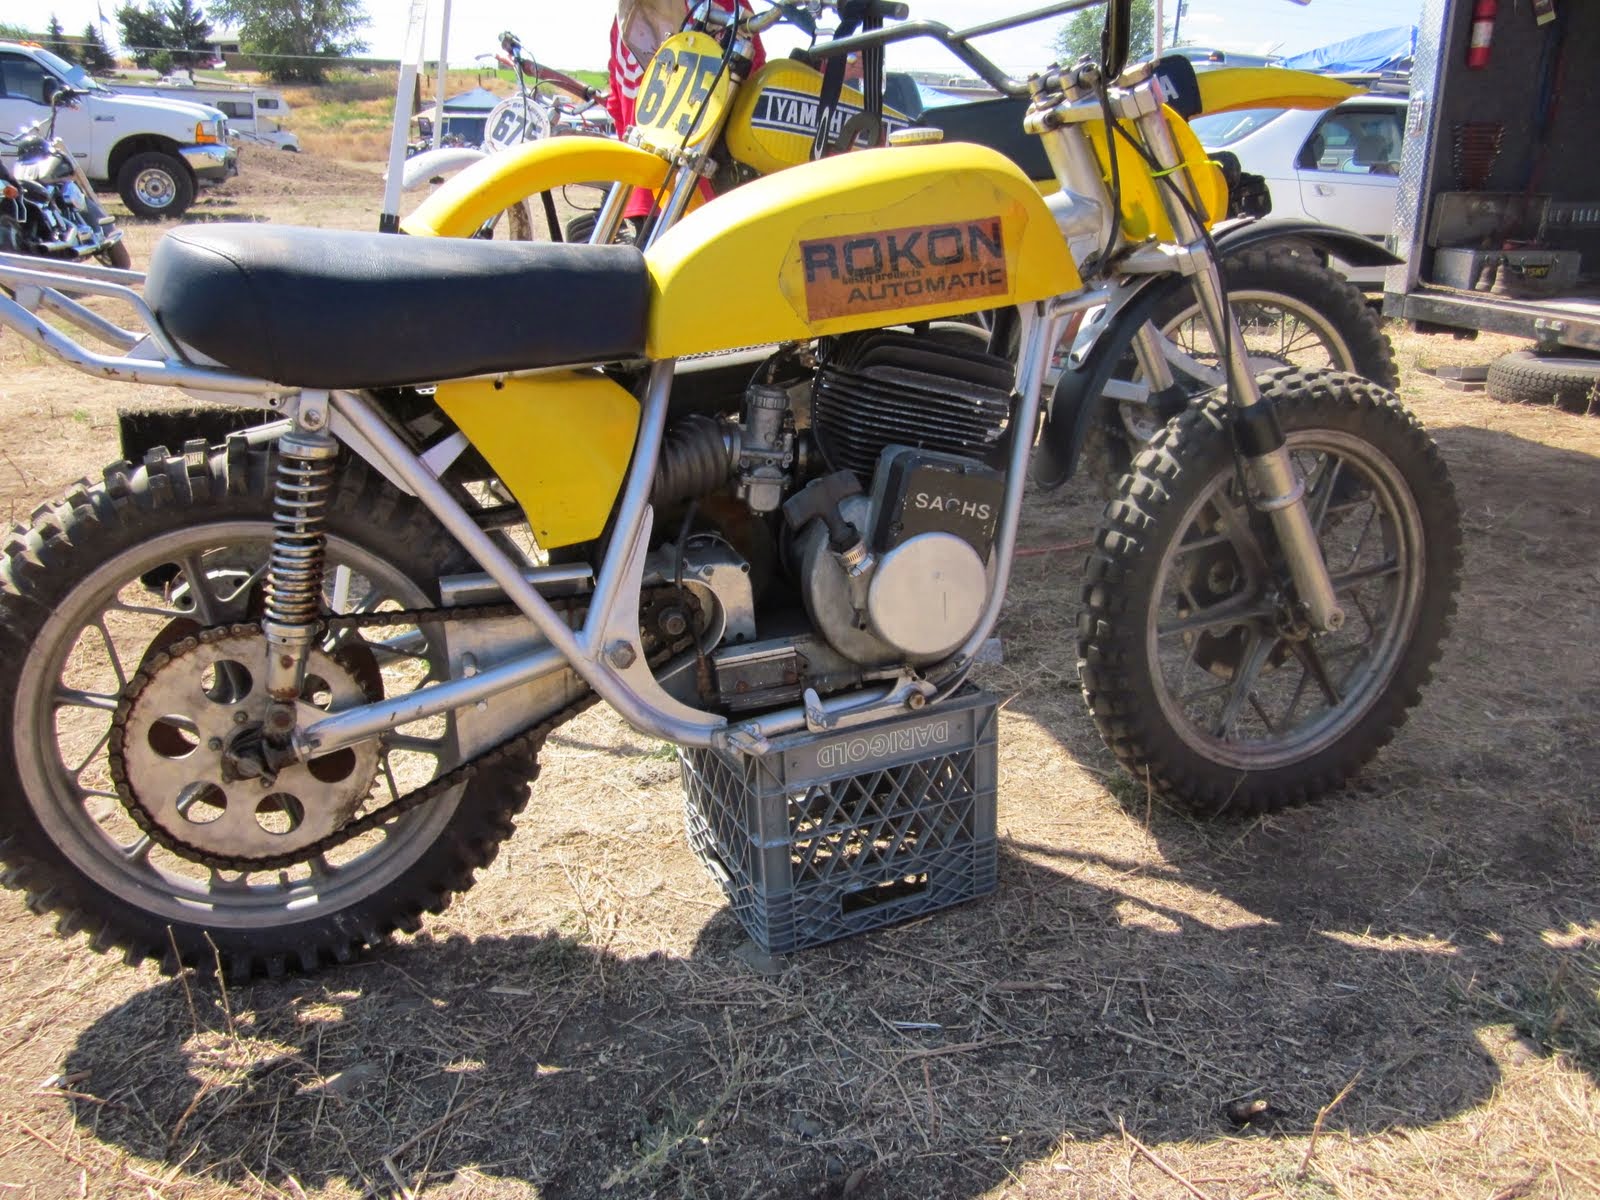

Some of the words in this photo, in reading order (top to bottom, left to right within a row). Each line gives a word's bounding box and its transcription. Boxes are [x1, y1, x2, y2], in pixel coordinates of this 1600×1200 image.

[636, 47, 722, 136] 675
[775, 97, 853, 134] YAMH
[803, 222, 1001, 282] ROKON
[847, 269, 1003, 304] AUTOMATIC
[915, 492, 991, 520] SACHS
[816, 721, 949, 768] DARIGOLD
